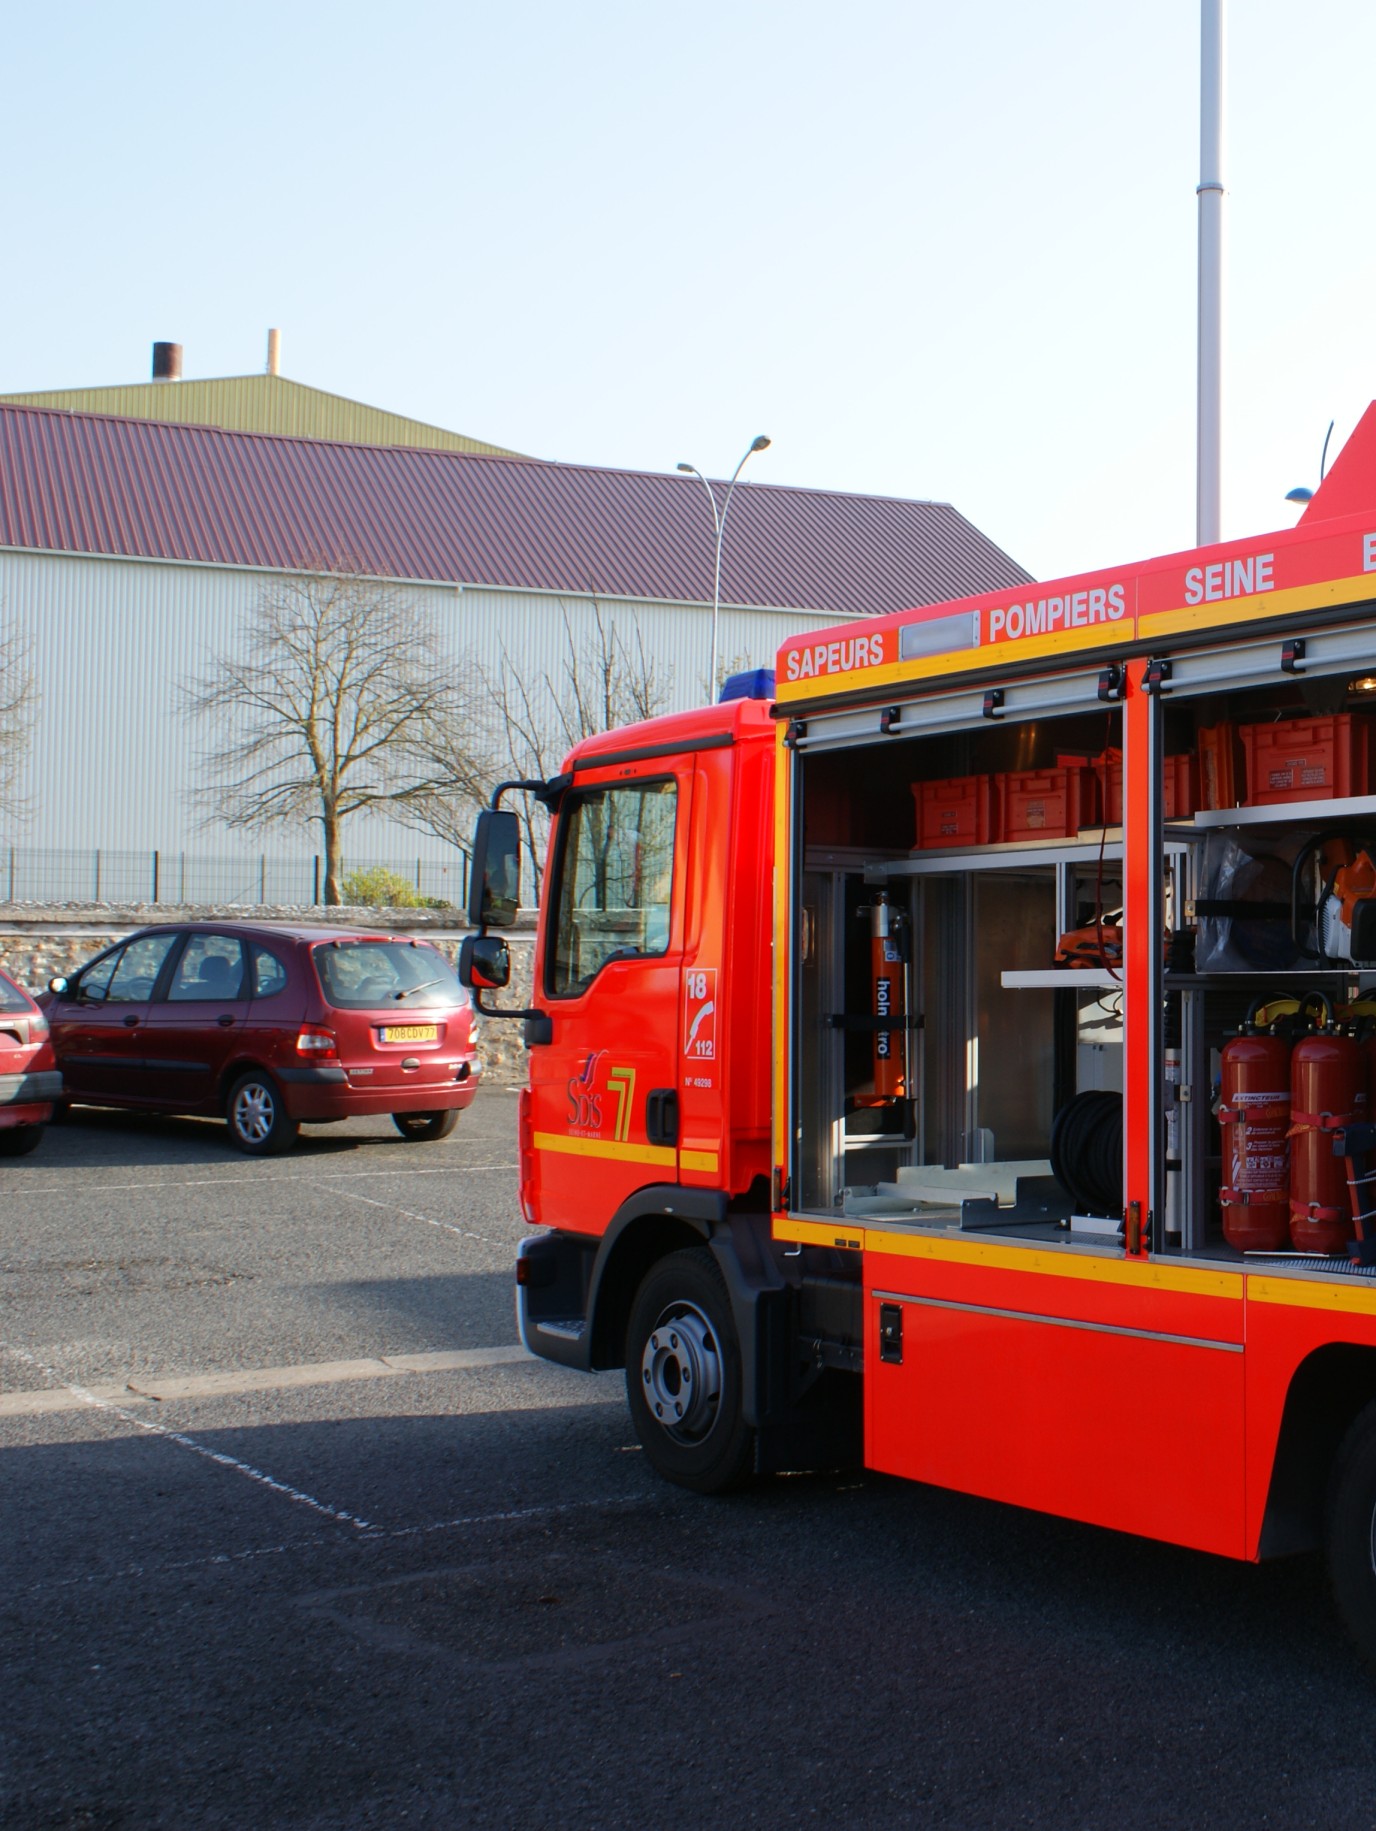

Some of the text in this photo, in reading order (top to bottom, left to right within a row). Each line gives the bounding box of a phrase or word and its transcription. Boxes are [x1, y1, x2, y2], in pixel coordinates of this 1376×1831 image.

[787, 633, 884, 680] SAPEURS
[989, 584, 1125, 643] POMPIERS
[1185, 554, 1275, 605] SEINE
[687, 973, 707, 999] 18
[695, 1040, 713, 1056] 112
